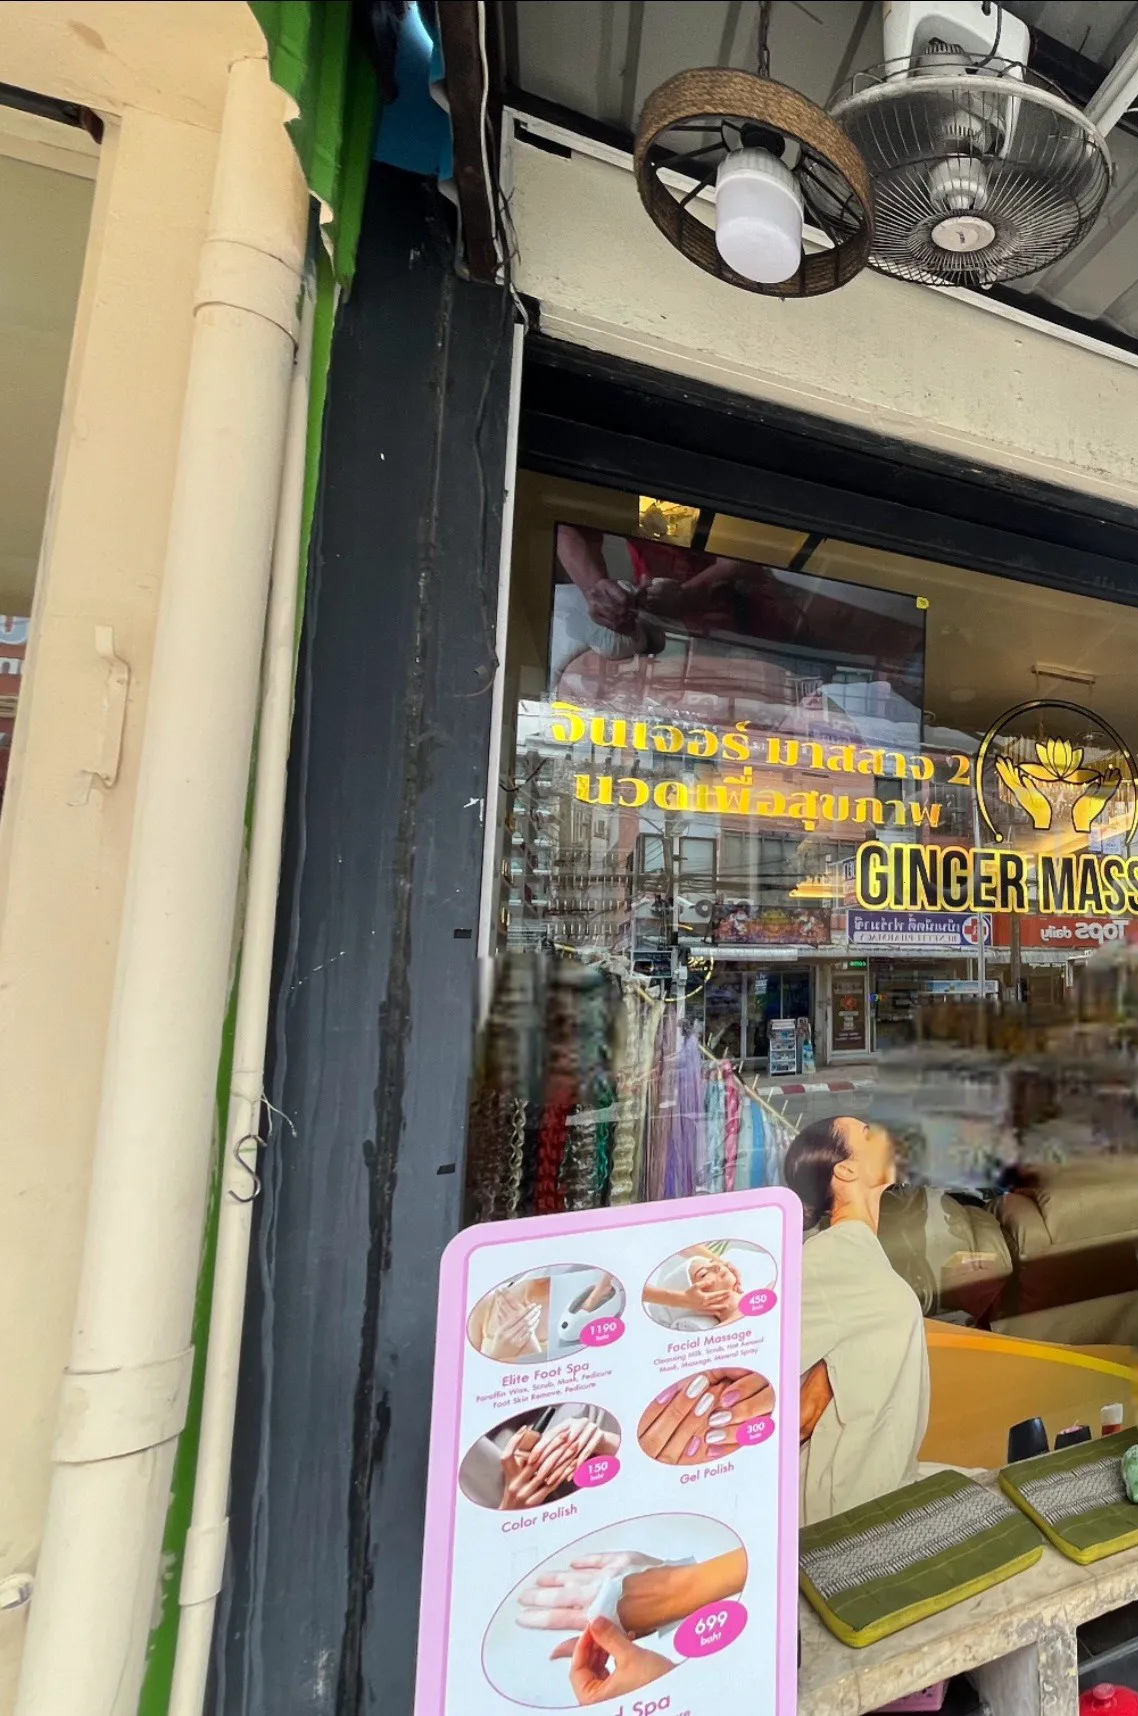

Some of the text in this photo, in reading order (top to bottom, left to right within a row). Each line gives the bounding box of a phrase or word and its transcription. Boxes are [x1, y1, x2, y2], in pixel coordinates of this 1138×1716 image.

[551, 701, 751, 761] จินเจอร์
[947, 755, 970, 785] 2
[573, 766, 942, 832] นวดเพื่อสุขภาพ
[856, 841, 1029, 913] GINGER
[749, 1294, 767, 1305] 450
[590, 1322, 617, 1335] 1190
[667, 1330, 752, 1353] Facial Massage
[740, 1347, 759, 1358] Spray
[476, 1391, 506, 1403] Paraffin
[581, 1369, 612, 1381] Pedicure
[502, 1362, 589, 1387] Elite Foot Spa
[493, 1400, 511, 1409] Foot
[513, 1396, 529, 1405] Skin
[564, 1382, 596, 1393] Pedicure
[747, 1422, 765, 1434] 300
[588, 1462, 608, 1474] 150
[680, 1462, 735, 1486] Gel Polish
[501, 1504, 578, 1533] Color Polish
[695, 1611, 728, 1635] 699
[701, 1631, 722, 1646] baht
